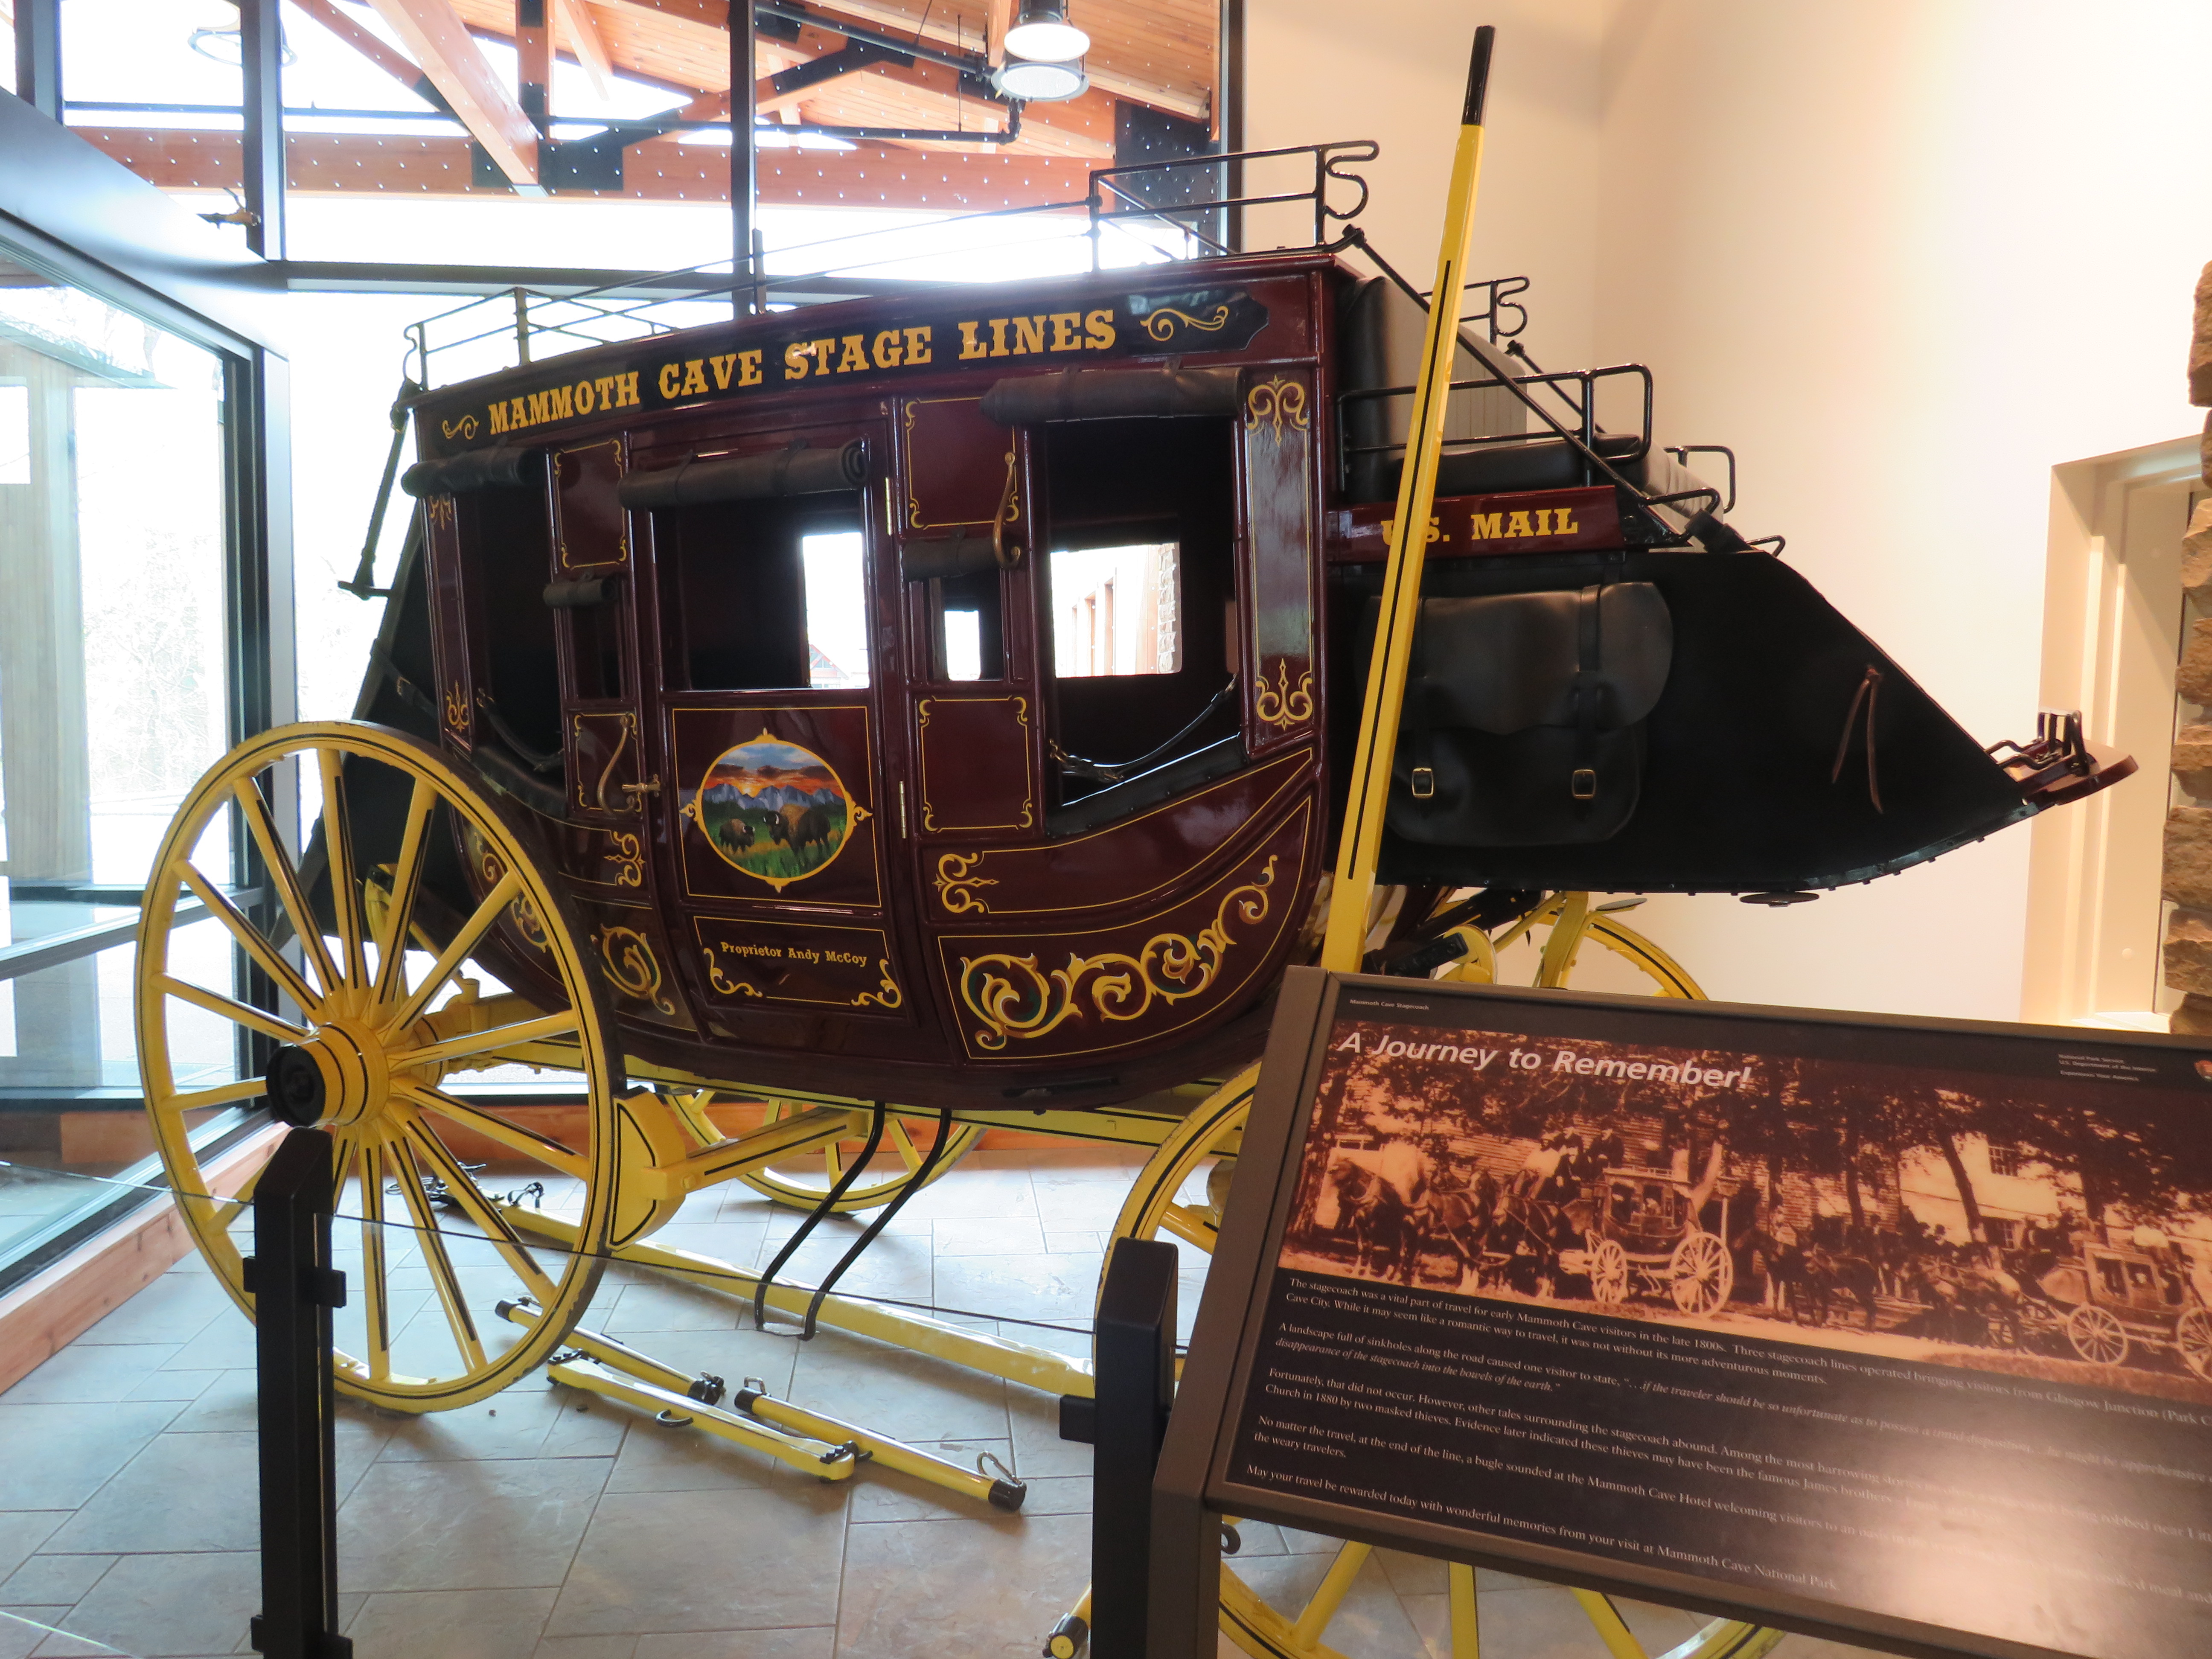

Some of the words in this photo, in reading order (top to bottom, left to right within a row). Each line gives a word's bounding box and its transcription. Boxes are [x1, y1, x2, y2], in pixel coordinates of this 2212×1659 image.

[489, 371, 640, 434] MAMMOTH
[658, 349, 763, 399] CAVE
[785, 327, 931, 379] STAGE
[958, 310, 1116, 359] LINES
[1380, 517, 1449, 545] US.
[1470, 508, 1578, 540] MAIL
[720, 942, 782, 957] Proprietor
[788, 947, 820, 964] Andy
[825, 950, 867, 968] McCoy
[1337, 1032, 1361, 1054] A
[1371, 1035, 1499, 1071] Journey
[1509, 1048, 1541, 1070] to
[1553, 1051, 1752, 1089] Remember!
[1275, 1337, 1341, 1356] disappearance
[1342, 1349, 1354, 1360] of
[1353, 1350, 1368, 1361] the
[1369, 1354, 1420, 1369] stagecoach
[1421, 1361, 1441, 1373] into
[1442, 1365, 1458, 1376] the
[1459, 1367, 1493, 1382] bowels
[1494, 1374, 1507, 1385] of
[1506, 1376, 1522, 1387] the
[1278, 1321, 1286, 1332] A
[1289, 1323, 1335, 1341] landscape
[1336, 1331, 1353, 1342] full
[1354, 1335, 1366, 1344] of
[1366, 1337, 1412, 1351] sinkholes
[1414, 1344, 1441, 1359] along
[1443, 1348, 1459, 1359] the
[1461, 1353, 1485, 1364] road
[1486, 1358, 1522, 1370] caused
[1523, 1364, 1543, 1373] one
[1545, 1367, 1578, 1378] visitor
[1580, 1372, 1591, 1380] to
[1592, 1375, 1621, 1387] state,
[1652, 1382, 1669, 1394] the
[1670, 1387, 1713, 1400] traveler
[1286, 1292, 1309, 1304] Cave
[1310, 1296, 1330, 1309] City.
[1334, 1299, 1361, 1312] While
[1363, 1304, 1369, 1314] it
[1371, 1308, 1392, 1319] may
[1393, 1311, 1417, 1321] seem
[1420, 1313, 1438, 1324] like
[1447, 1319, 1491, 1333] romantic
[1493, 1327, 1511, 1339] way
[1515, 1329, 1526, 1337] to
[1528, 1331, 1559, 1344] travel,
[1561, 1335, 1568, 1345] it
[1571, 1338, 1590, 1348] was
[1592, 1342, 1610, 1351] not
[1612, 1345, 1653, 1358] without
[1656, 1349, 1669, 1359] its
[1671, 1354, 1699, 1365] more
[1701, 1357, 1770, 1376] adventurous
[1772, 1369, 1828, 1385] moments.
[1289, 1278, 1307, 1289] The
[1309, 1283, 1359, 1296] stagecoach
[1361, 1291, 1379, 1299] was
[1388, 1293, 1409, 1304] vital
[1409, 1298, 1430, 1307] part
[1432, 1300, 1444, 1310] of
[1444, 1302, 1472, 1314] travel
[1474, 1306, 1489, 1316] for
[1490, 1310, 1513, 1322] early
[1516, 1312, 1570, 1329] Mammoth
[1572, 1321, 1598, 1333] Cave
[1600, 1325, 1637, 1339] visitors
[1639, 1330, 1650, 1341] in
[1652, 1333, 1669, 1344] the
[1672, 1335, 1691, 1347] late
[1695, 1339, 1727, 1352] 1800s.
[1735, 1345, 1765, 1358] Three
[1767, 1352, 1828, 1367] stagecoach
[1254, 1432, 1270, 1443] the
[1272, 1437, 1299, 1451] weary
[1303, 1442, 1347, 1458] travelers.
[1265, 1383, 1301, 1398] Church
[1303, 1390, 1313, 1400] in
[1316, 1392, 1339, 1404] 1880
[1340, 1396, 1352, 1409] by
[1353, 1400, 1373, 1411] two
[1374, 1405, 1412, 1418] masked
[1414, 1410, 1452, 1426] thieves.
[1455, 1417, 1501, 1434] Evidence
[1503, 1425, 1527, 1438] later
[1529, 1429, 1578, 1448] indicated
[1580, 1439, 1609, 1453] these
[1611, 1445, 1650, 1460] thieves
[1652, 1454, 1674, 1467] may
[1677, 1455, 1703, 1470] have
[1706, 1460, 1734, 1475] been
[1736, 1467, 1755, 1479] the
[1269, 1367, 1324, 1388] Fortunately,
[1327, 1378, 1345, 1390] that
[1347, 1382, 1364, 1393] did
[1366, 1387, 1382, 1397] not
[1385, 1391, 1415, 1402] occur.
[1418, 1394, 1465, 1412] However,
[1467, 1403, 1496, 1416] other
[1498, 1408, 1522, 1420] tales
[1523, 1415, 1589, 1434] surrounding
[1591, 1423, 1609, 1435] the
[1610, 1429, 1670, 1446] stagecoach
[1672, 1438, 1717, 1454] abound.
[1720, 1446, 1762, 1464] Among
[1764, 1453, 1783, 1466] the
[1786, 1459, 1814, 1471] most
[1258, 1415, 1274, 1426] No
[1275, 1420, 1307, 1433] matter
[1309, 1425, 1325, 1436] the
[1327, 1429, 1356, 1444] travel,
[1358, 1436, 1368, 1444] at
[1370, 1436, 1387, 1448] the
[1388, 1441, 1408, 1452] end
[1410, 1444, 1423, 1454] of
[1423, 1446, 1440, 1458] the
[1442, 1449, 1464, 1464] line,
[1475, 1455, 1504, 1470] bugle
[1505, 1464, 1552, 1479] sounded
[1554, 1472, 1564, 1481] at
[1567, 1473, 1585, 1485] the
[1587, 1475, 1646, 1496] Mammoth
[1648, 1487, 1676, 1502] Cave
[1679, 1492, 1711, 1508] Hotel
[1714, 1501, 1778, 1523] welcoming
[1246, 1464, 1266, 1479] May
[1269, 1471, 1294, 1482] your
[1295, 1476, 1323, 1488] travel
[1324, 1479, 1337, 1491] be
[1339, 1485, 1388, 1501] rewarded
[1389, 1493, 1418, 1509] today
[1420, 1500, 1443, 1512] with
[1446, 1505, 1501, 1523] wonderful
[1503, 1517, 1557, 1534] memories
[1559, 1525, 1586, 1540] from
[1588, 1534, 1615, 1546] your
[1617, 1538, 1640, 1551] visit
[1643, 1545, 1653, 1554] at
[1657, 1545, 1719, 1567] Mammoth
[1721, 1558, 1751, 1573] Cave
[1754, 1563, 1806, 1584] National
[1810, 1574, 1841, 1592] Park.
